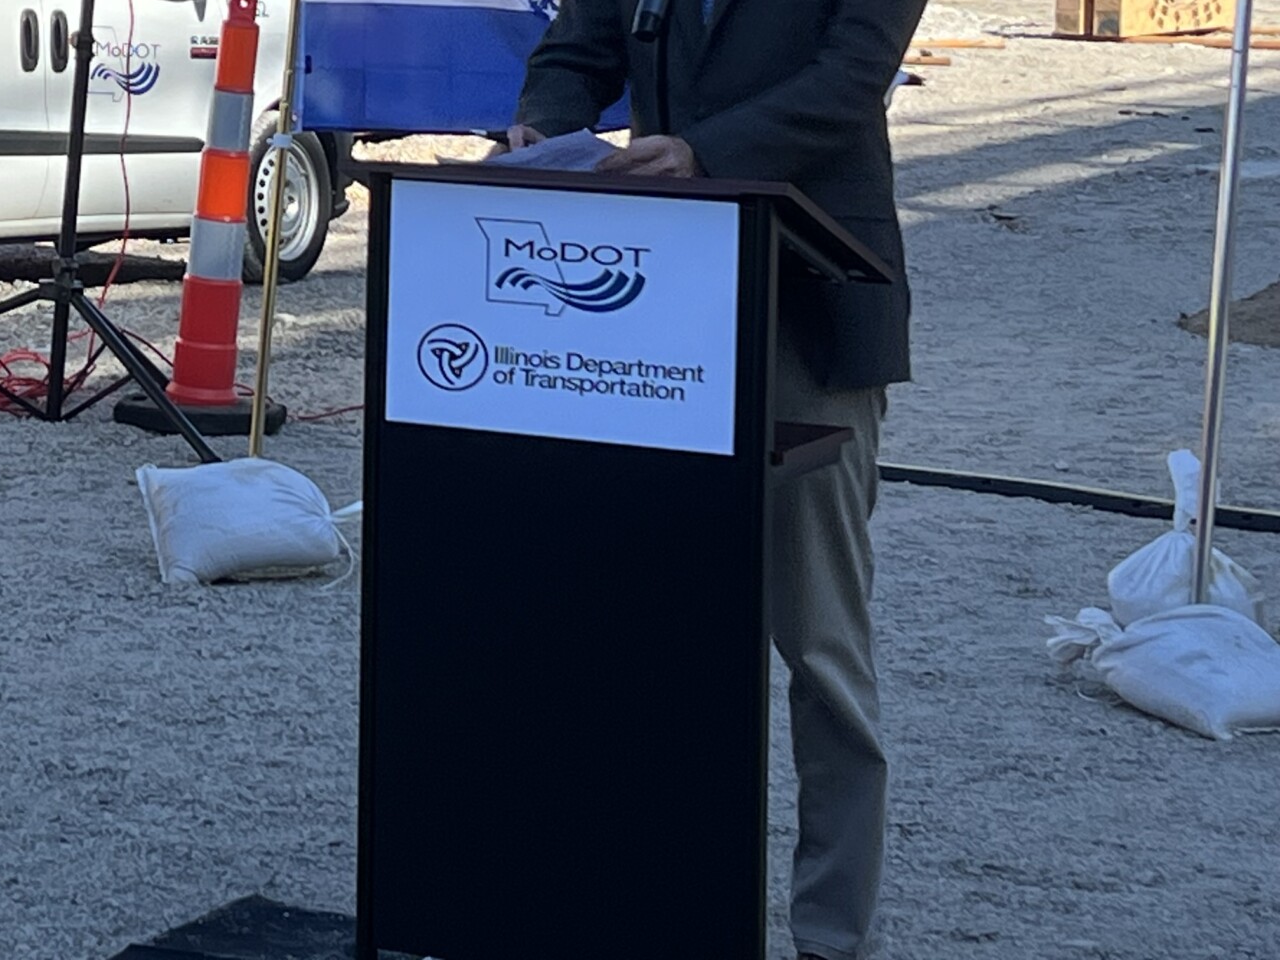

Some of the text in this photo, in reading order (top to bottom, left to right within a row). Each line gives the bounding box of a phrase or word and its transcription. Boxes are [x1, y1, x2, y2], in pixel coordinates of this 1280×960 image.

[94, 41, 162, 59] MoDOT
[504, 238, 652, 268] MoDOT
[494, 345, 706, 383] Illinois Department
[492, 367, 686, 401] of Transportation
